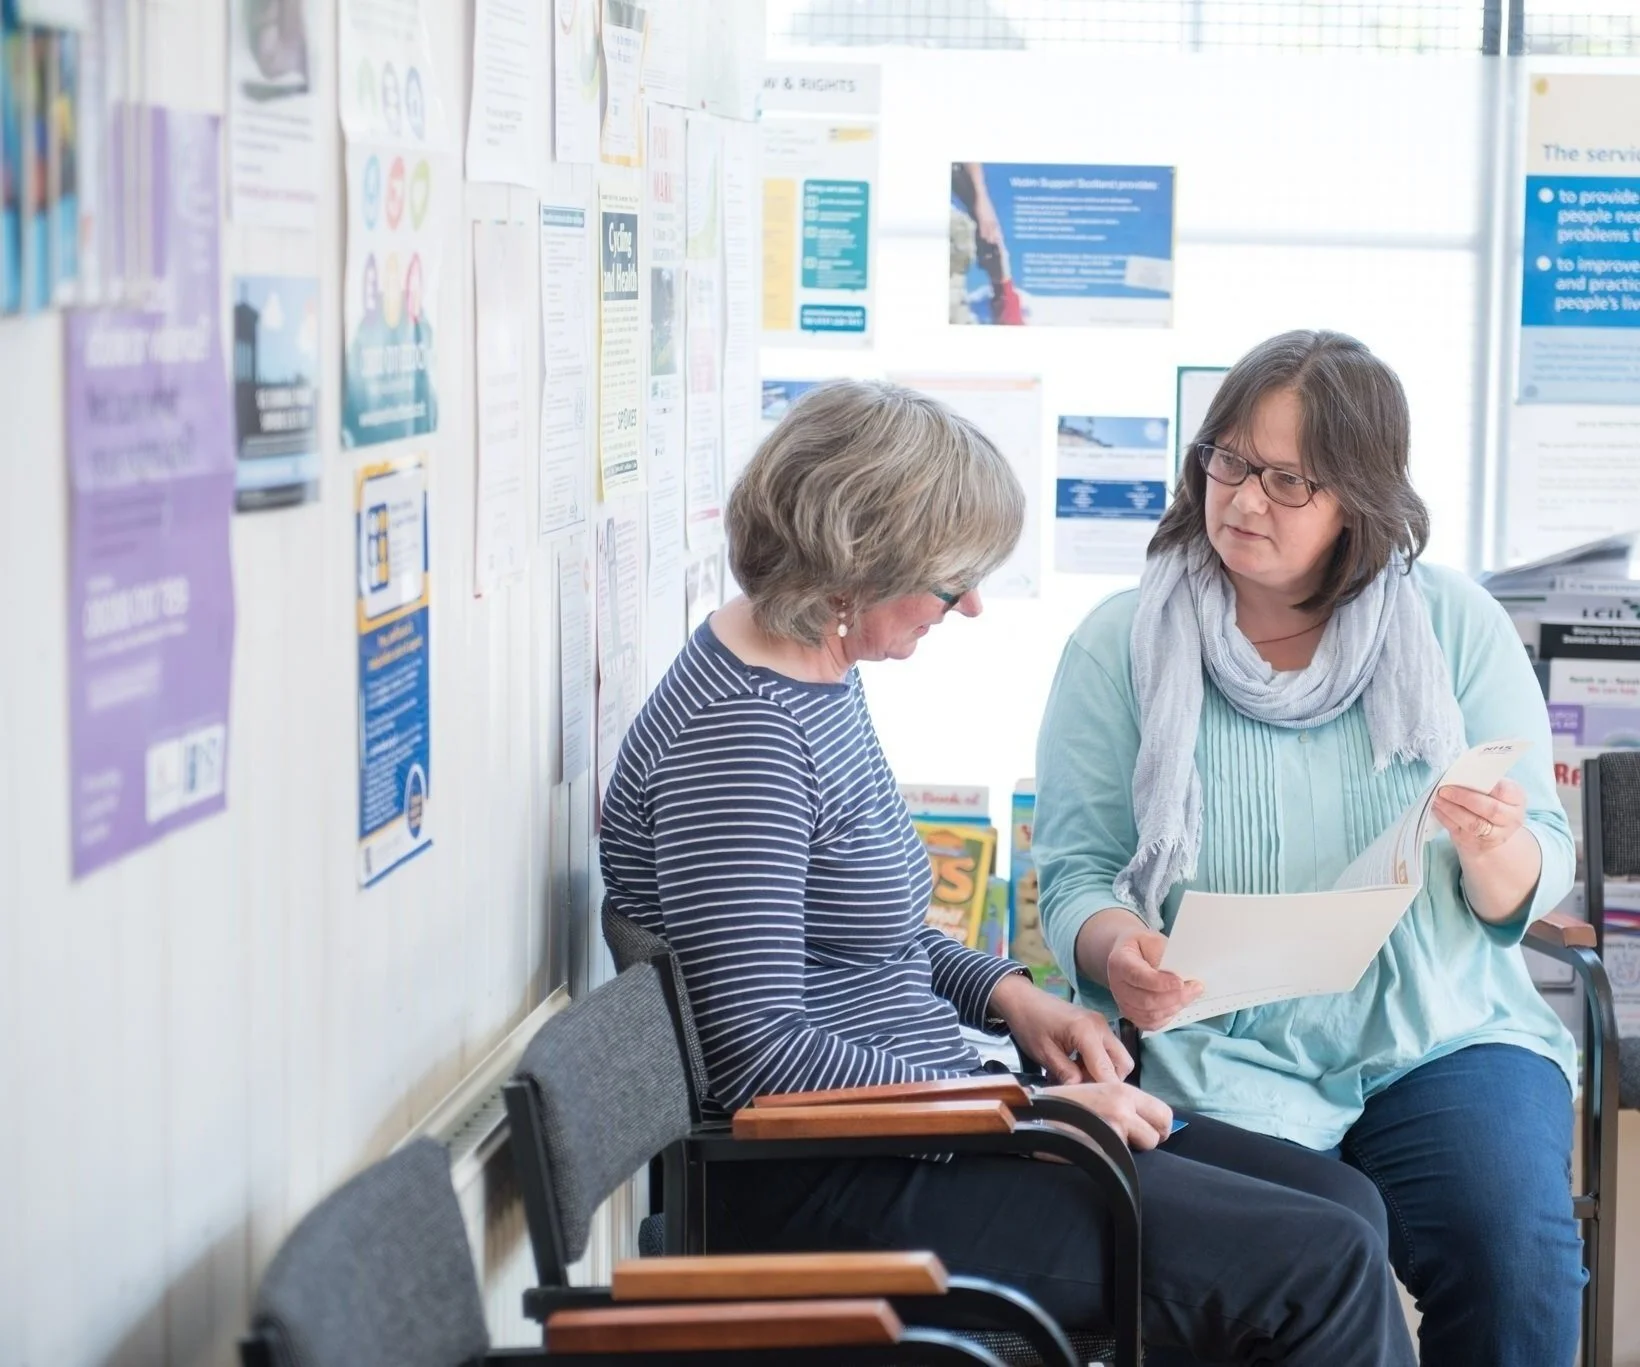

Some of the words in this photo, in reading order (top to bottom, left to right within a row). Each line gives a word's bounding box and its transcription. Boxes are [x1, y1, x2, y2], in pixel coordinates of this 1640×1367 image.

[800, 77, 857, 93] RIGHTS
[1542, 142, 1580, 162] The
[1558, 188, 1578, 204] to
[1580, 186, 1640, 207] provide
[1557, 207, 1613, 225] people
[608, 221, 632, 259] Cycling
[1557, 226, 1630, 244] problems
[1556, 257, 1575, 272] to
[1577, 255, 1640, 275] improve
[604, 262, 615, 292] and
[616, 262, 638, 293] Health
[1555, 276, 1587, 291] and
[1554, 295, 1620, 313] people's
